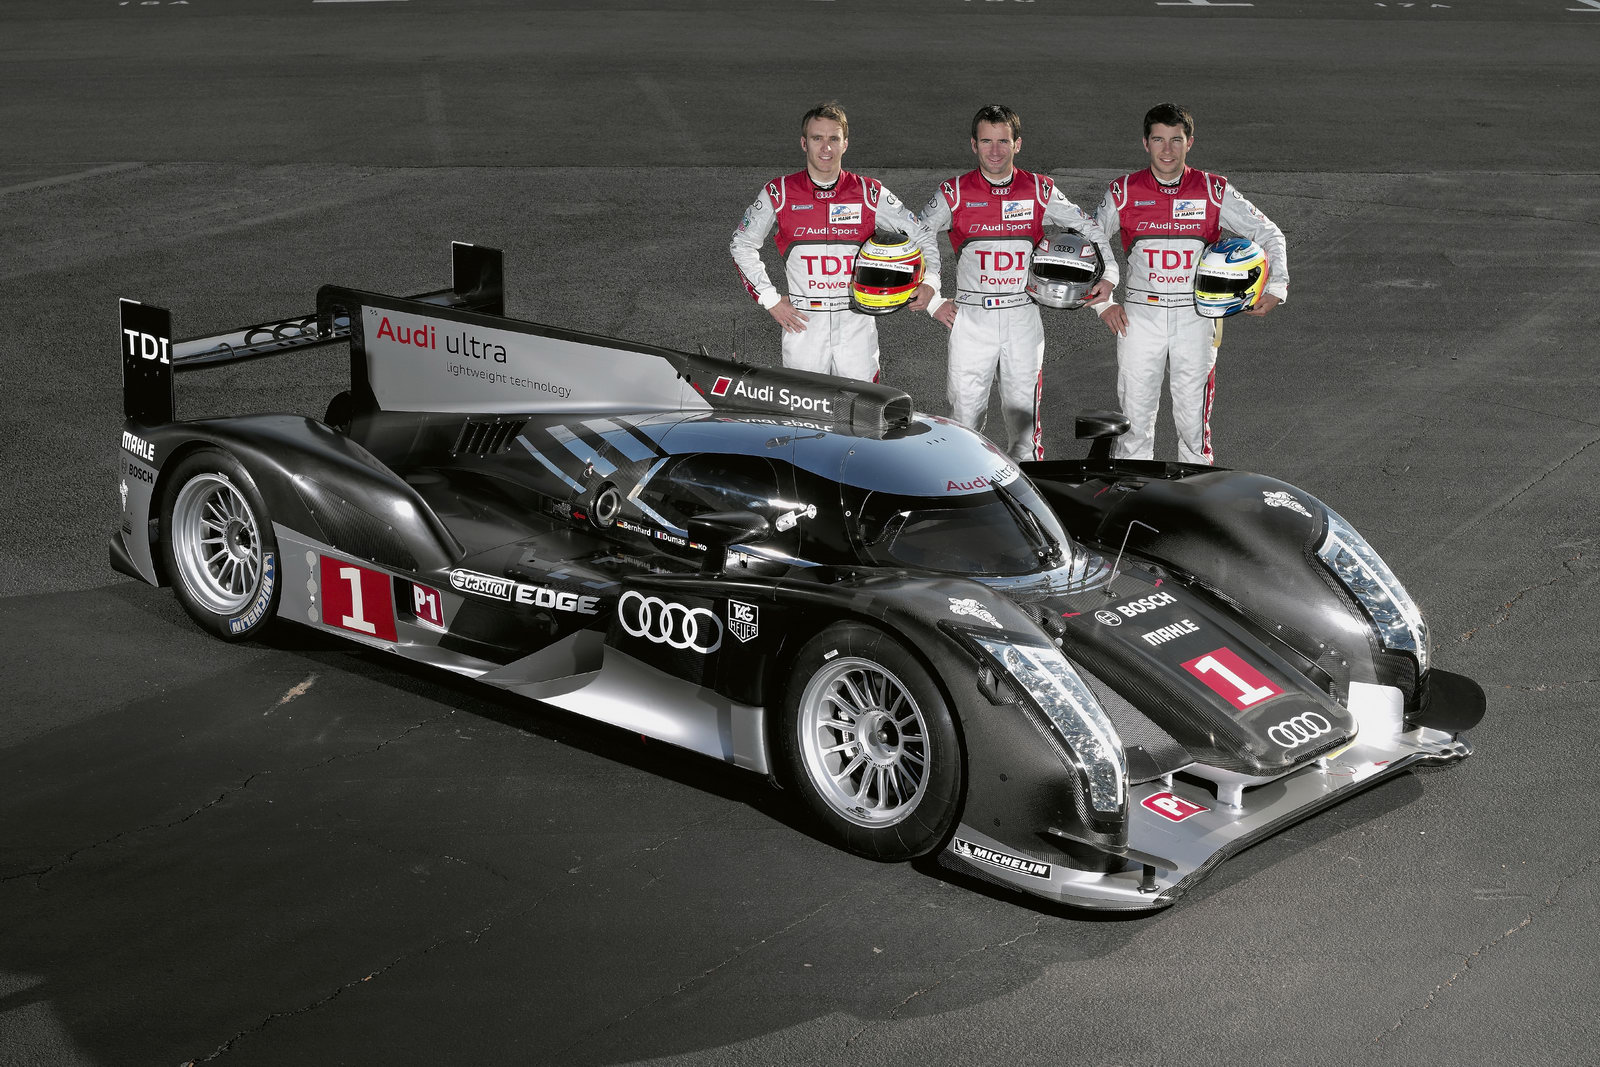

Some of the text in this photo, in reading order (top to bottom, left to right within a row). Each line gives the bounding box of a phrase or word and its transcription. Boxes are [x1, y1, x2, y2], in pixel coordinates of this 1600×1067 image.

[806, 226, 859, 236] Audi Sport
[981, 222, 1032, 232] Audi Sport
[1148, 222, 1201, 232] Audi Sport
[800, 255, 857, 276] TDI
[974, 250, 1026, 271] TDI
[1142, 248, 1194, 270] TDI
[808, 279, 851, 290] Power
[980, 275, 1022, 285] Power
[1148, 272, 1190, 284] Power
[123, 328, 170, 366] TDI
[376, 316, 508, 364] Audi ultra
[446, 361, 572, 399] lightweight technology
[733, 380, 832, 414] Audi Sport
[121, 430, 155, 462] MAHLE
[128, 463, 154, 484] BOSCH
[946, 463, 1016, 492] Audi ultra
[622, 520, 652, 537] Bernhard
[662, 532, 686, 546] Dumas
[231, 574, 273, 633] MICHELIN
[339, 567, 376, 635] 1
[412, 584, 438, 621] P1
[464, 574, 600, 616] Castrol EDGE
[1115, 591, 1178, 619] BOSCH
[733, 603, 755, 622] TAG
[730, 620, 757, 640] HEUER
[1140, 617, 1201, 647] MAHLE
[1194, 655, 1275, 706] 1
[1151, 794, 1201, 818] P1
[972, 847, 1048, 876] MICHELIN
